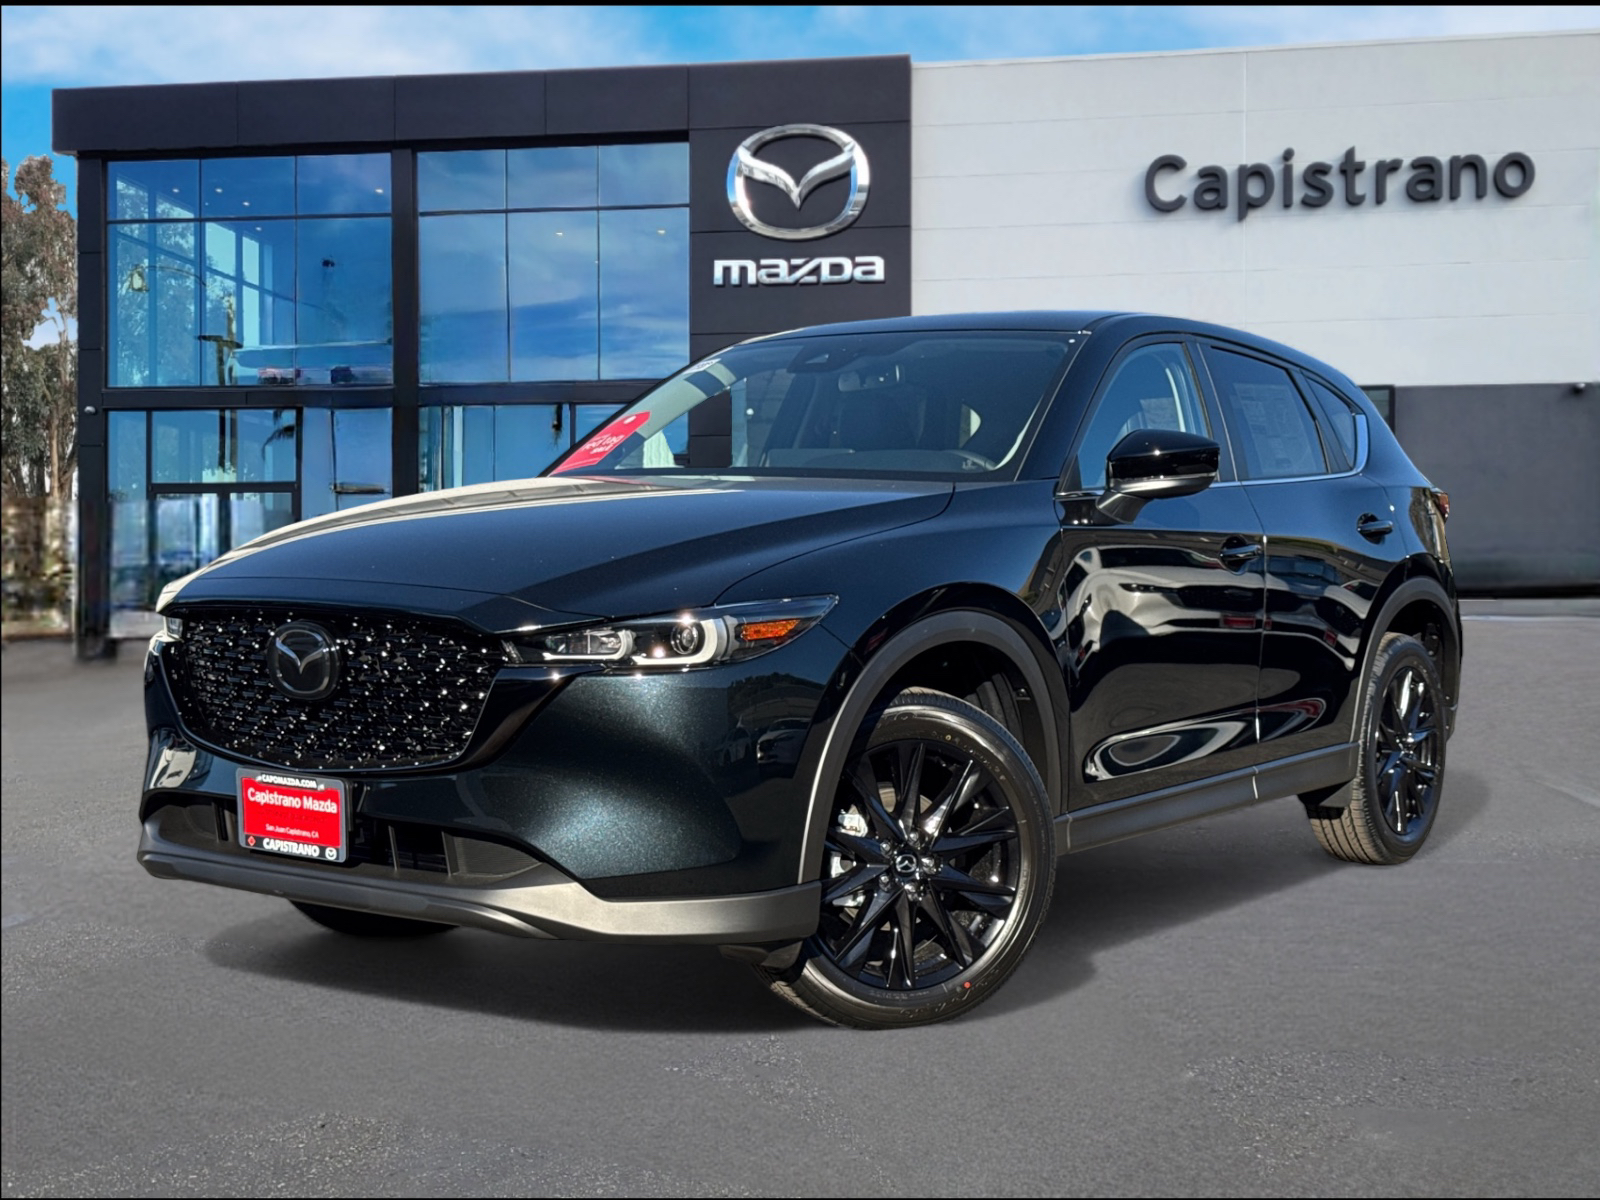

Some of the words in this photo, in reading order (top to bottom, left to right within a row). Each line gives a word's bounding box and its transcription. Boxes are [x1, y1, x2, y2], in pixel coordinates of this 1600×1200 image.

[1144, 146, 1536, 222] Capistrano
[247, 787, 301, 808] Capistrano
[303, 796, 338, 814] Mazda
[263, 838, 320, 857] CAPISTRANO
